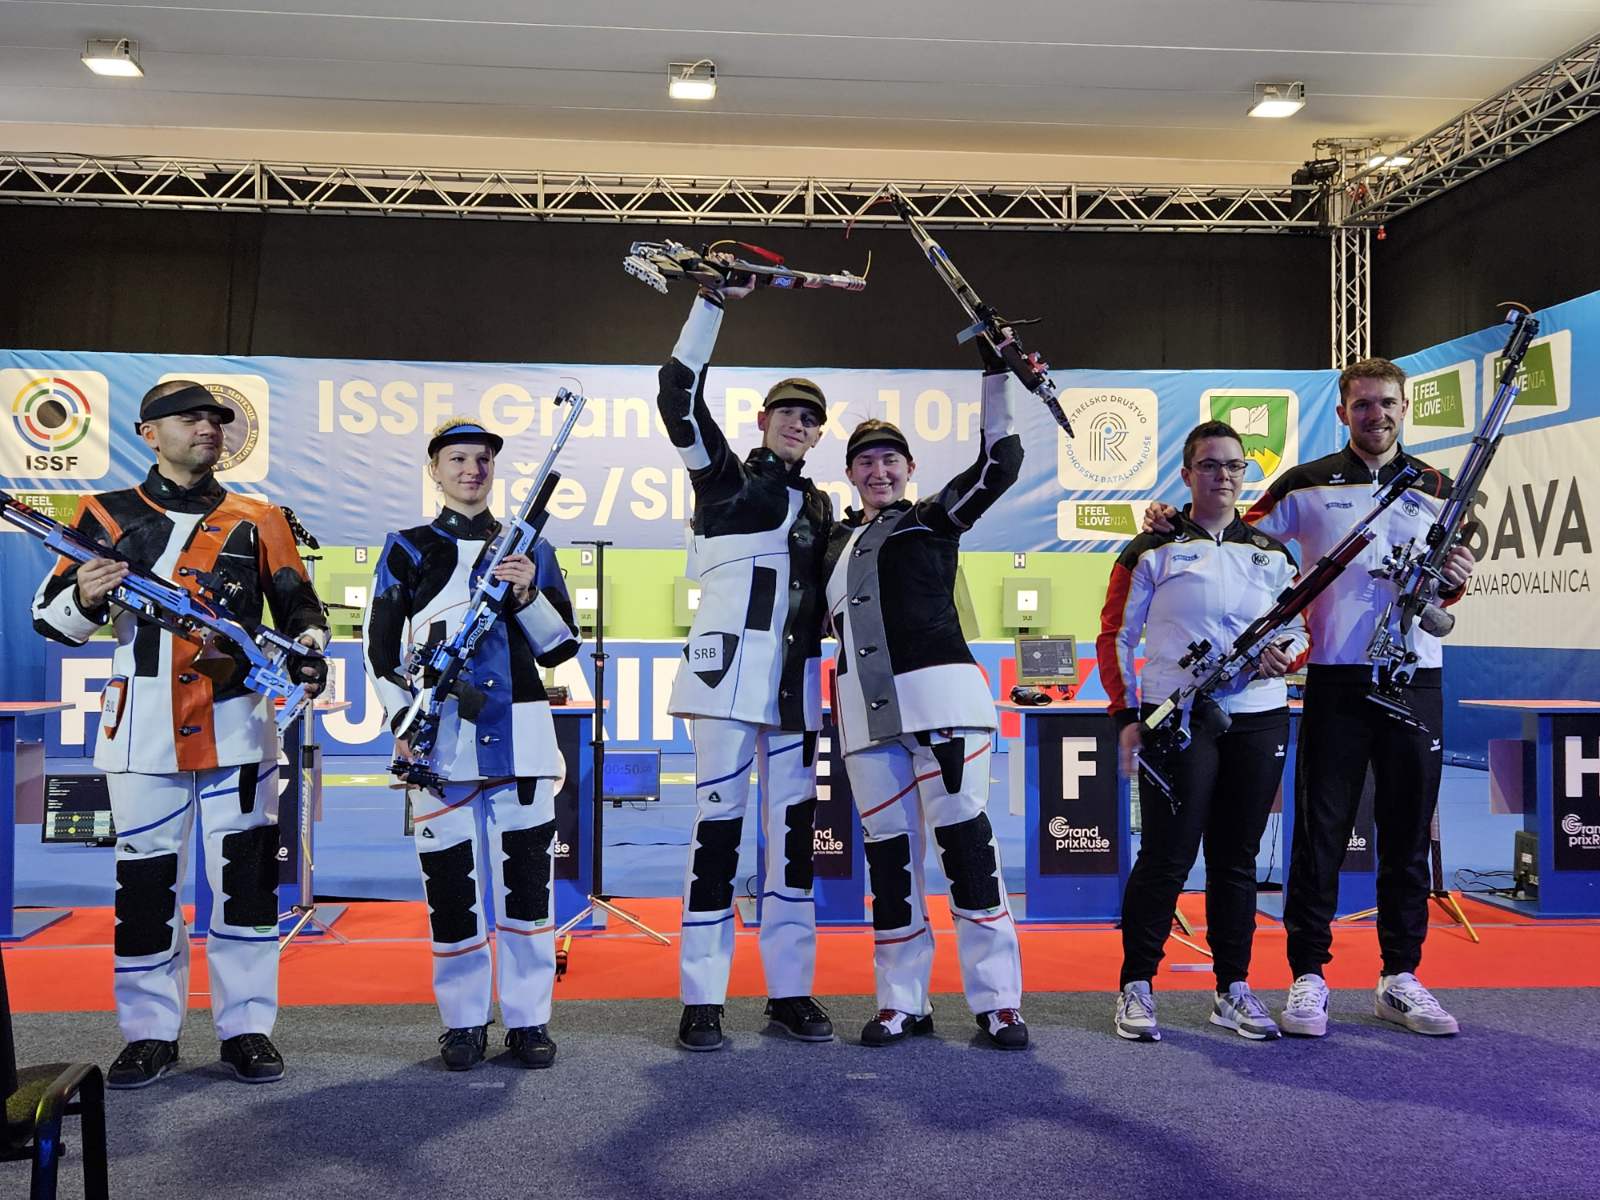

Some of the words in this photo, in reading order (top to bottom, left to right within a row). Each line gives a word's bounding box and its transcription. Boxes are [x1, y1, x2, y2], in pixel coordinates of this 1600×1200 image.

[1502, 359, 1527, 373] FL
[1420, 380, 1440, 400] FEEL
[318, 380, 446, 433] ISSF
[479, 383, 670, 438] Gran
[725, 388, 848, 440] Px
[1069, 395, 1108, 424] STRELSKO
[1110, 395, 1147, 424] DRUŠTVO
[26, 455, 78, 471] ISSF
[26, 495, 53, 506] FEEL
[32, 506, 74, 517] OVENIA
[1084, 506, 1109, 516] FEEL
[1078, 515, 1128, 526] SLOVENIA
[1466, 476, 1593, 563] SAVA
[356, 548, 367, 562] B
[581, 551, 593, 564] D
[1466, 569, 1591, 596] ZAVAROVALNICA
[693, 647, 717, 660] SRB
[1062, 736, 1097, 800] F
[1048, 816, 1099, 838] Grand
[1561, 814, 1600, 835] Gran
[1568, 834, 1600, 848] prixR
